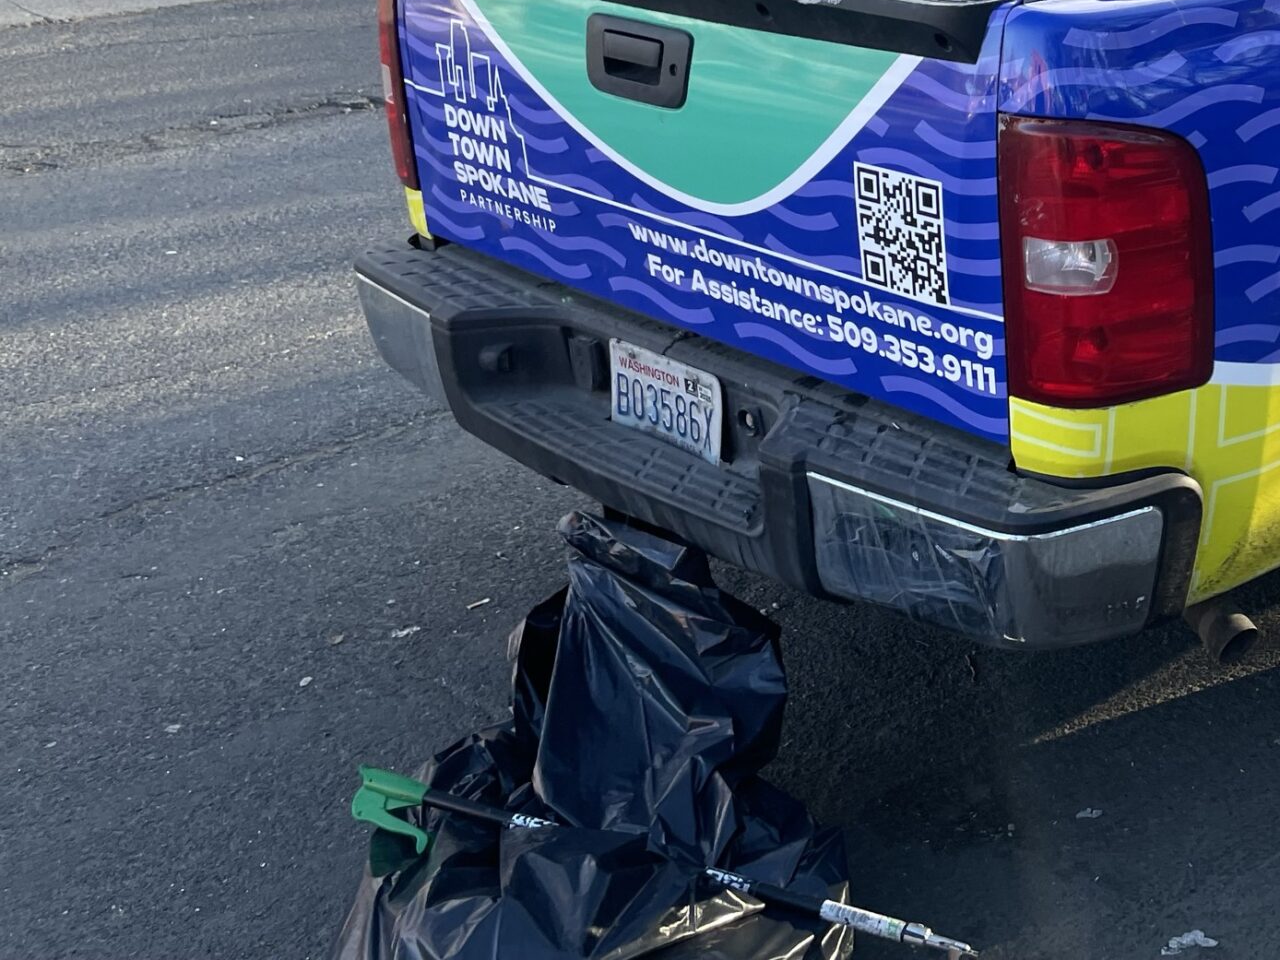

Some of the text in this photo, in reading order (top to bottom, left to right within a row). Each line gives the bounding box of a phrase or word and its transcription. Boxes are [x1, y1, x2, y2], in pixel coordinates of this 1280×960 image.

[443, 103, 508, 144] DOWN
[447, 131, 512, 173] TOWN
[453, 160, 552, 212] SPOKANE
[459, 189, 557, 233] PARTNERSHIP
[628, 221, 994, 359] www.downtownspokane.org
[648, 253, 997, 395] For Assistance: 509.353.9111
[618, 355, 680, 388] WASHINGTON
[617, 371, 714, 453] B03586X
